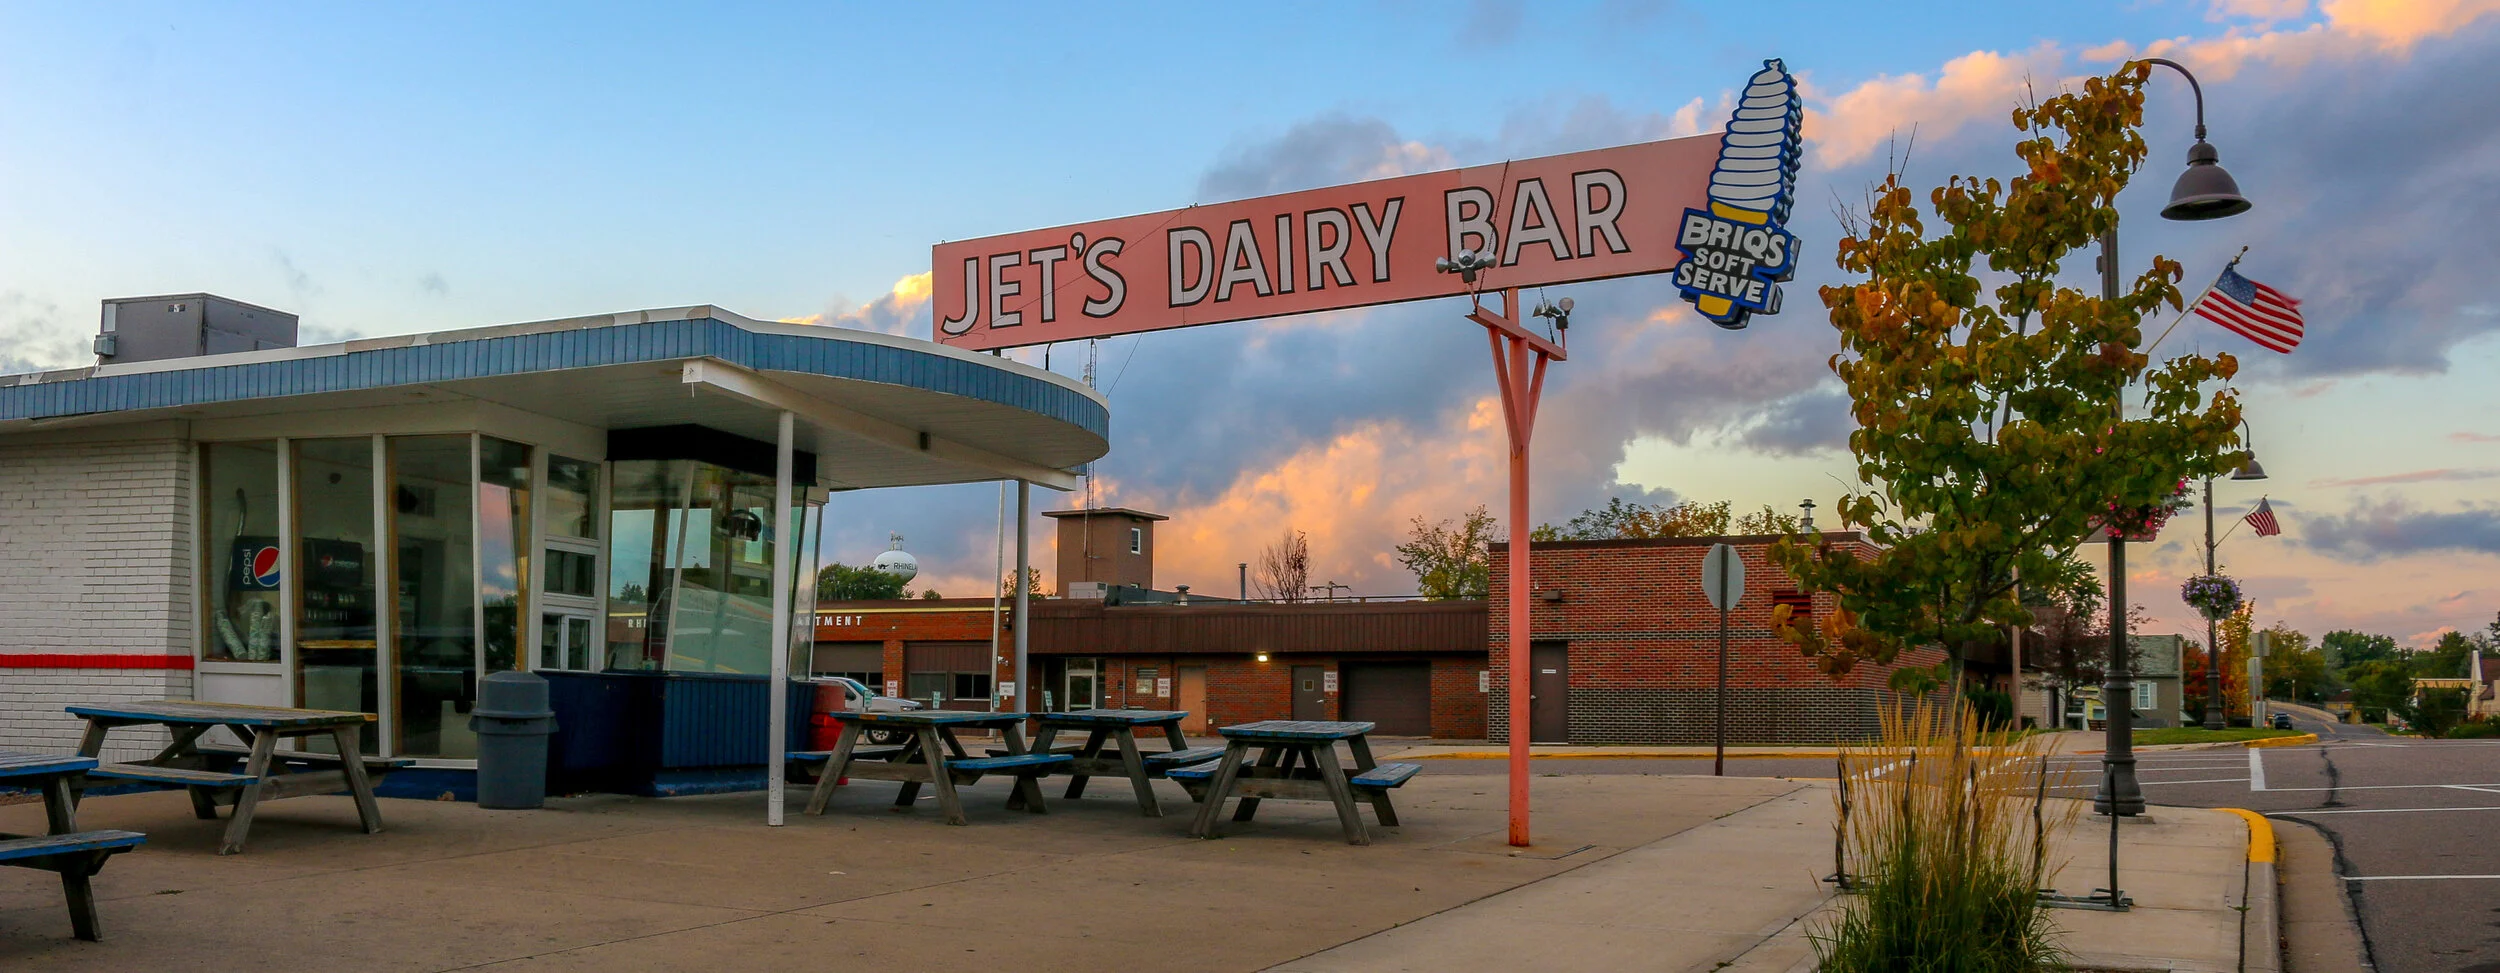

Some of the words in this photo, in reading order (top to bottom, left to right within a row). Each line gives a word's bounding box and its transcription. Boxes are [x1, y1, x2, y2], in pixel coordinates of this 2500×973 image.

[941, 231, 1127, 335] JET'S
[1167, 196, 1405, 309] DAIRY
[1444, 168, 1632, 274] BAR
[1680, 214, 1787, 267] BRIQ'S
[1693, 247, 1756, 276] SOFT
[1676, 262, 1765, 303] SERVE
[242, 548, 252, 585] pepsi
